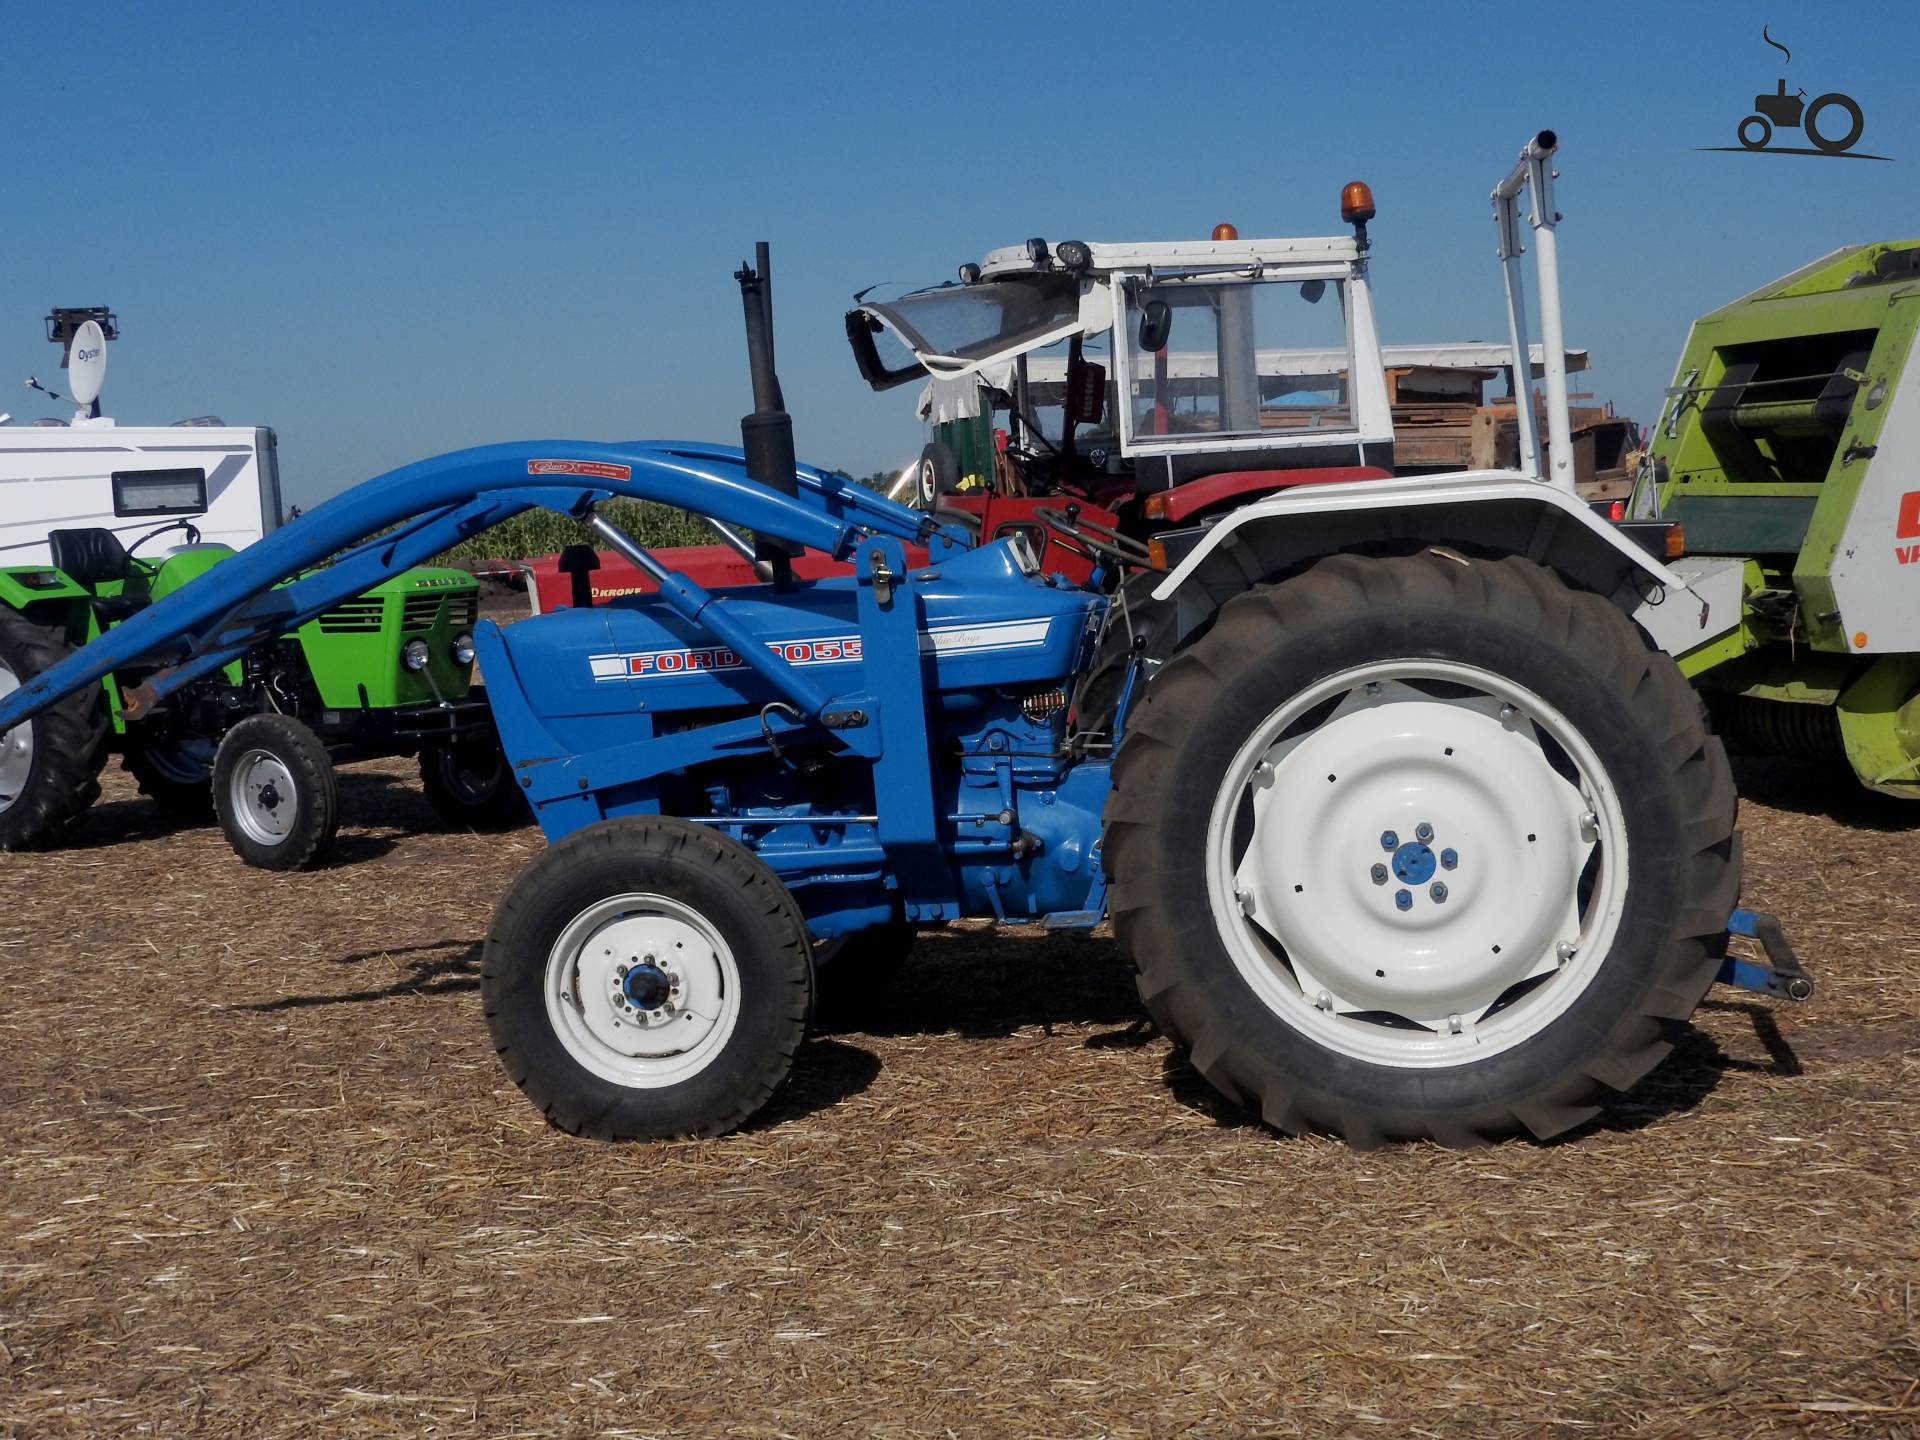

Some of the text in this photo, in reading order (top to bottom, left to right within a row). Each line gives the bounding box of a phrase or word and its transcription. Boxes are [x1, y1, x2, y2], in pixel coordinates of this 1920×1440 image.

[416, 577, 466, 587] DEUTZ
[600, 587, 641, 597] KRONE
[629, 650, 743, 674] FORD
